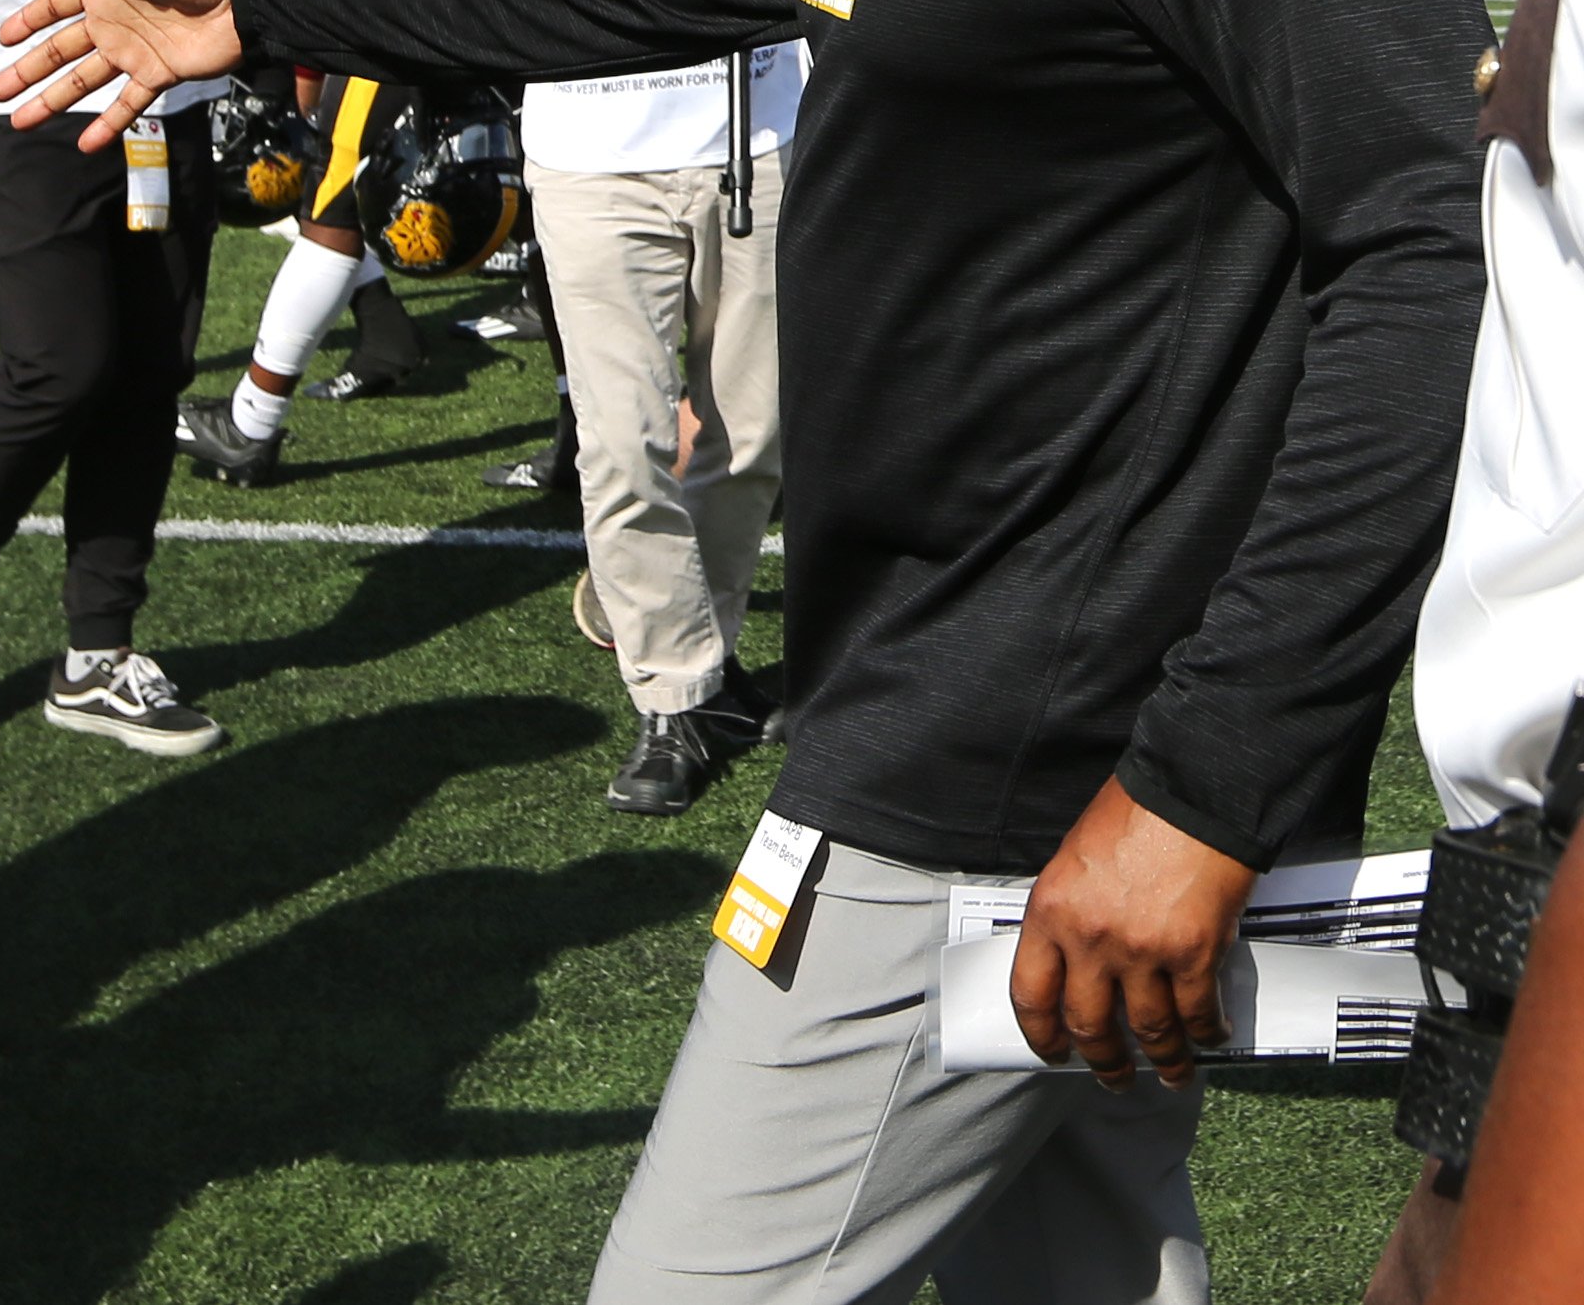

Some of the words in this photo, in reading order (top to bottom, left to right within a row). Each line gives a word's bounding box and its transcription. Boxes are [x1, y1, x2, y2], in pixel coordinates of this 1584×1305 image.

[601, 79, 630, 93] MUST
[633, 78, 645, 91] BE
[647, 76, 684, 90] WORN
[686, 73, 710, 87] FOR
[759, 830, 779, 855] Team
[778, 843, 804, 871] Bench
